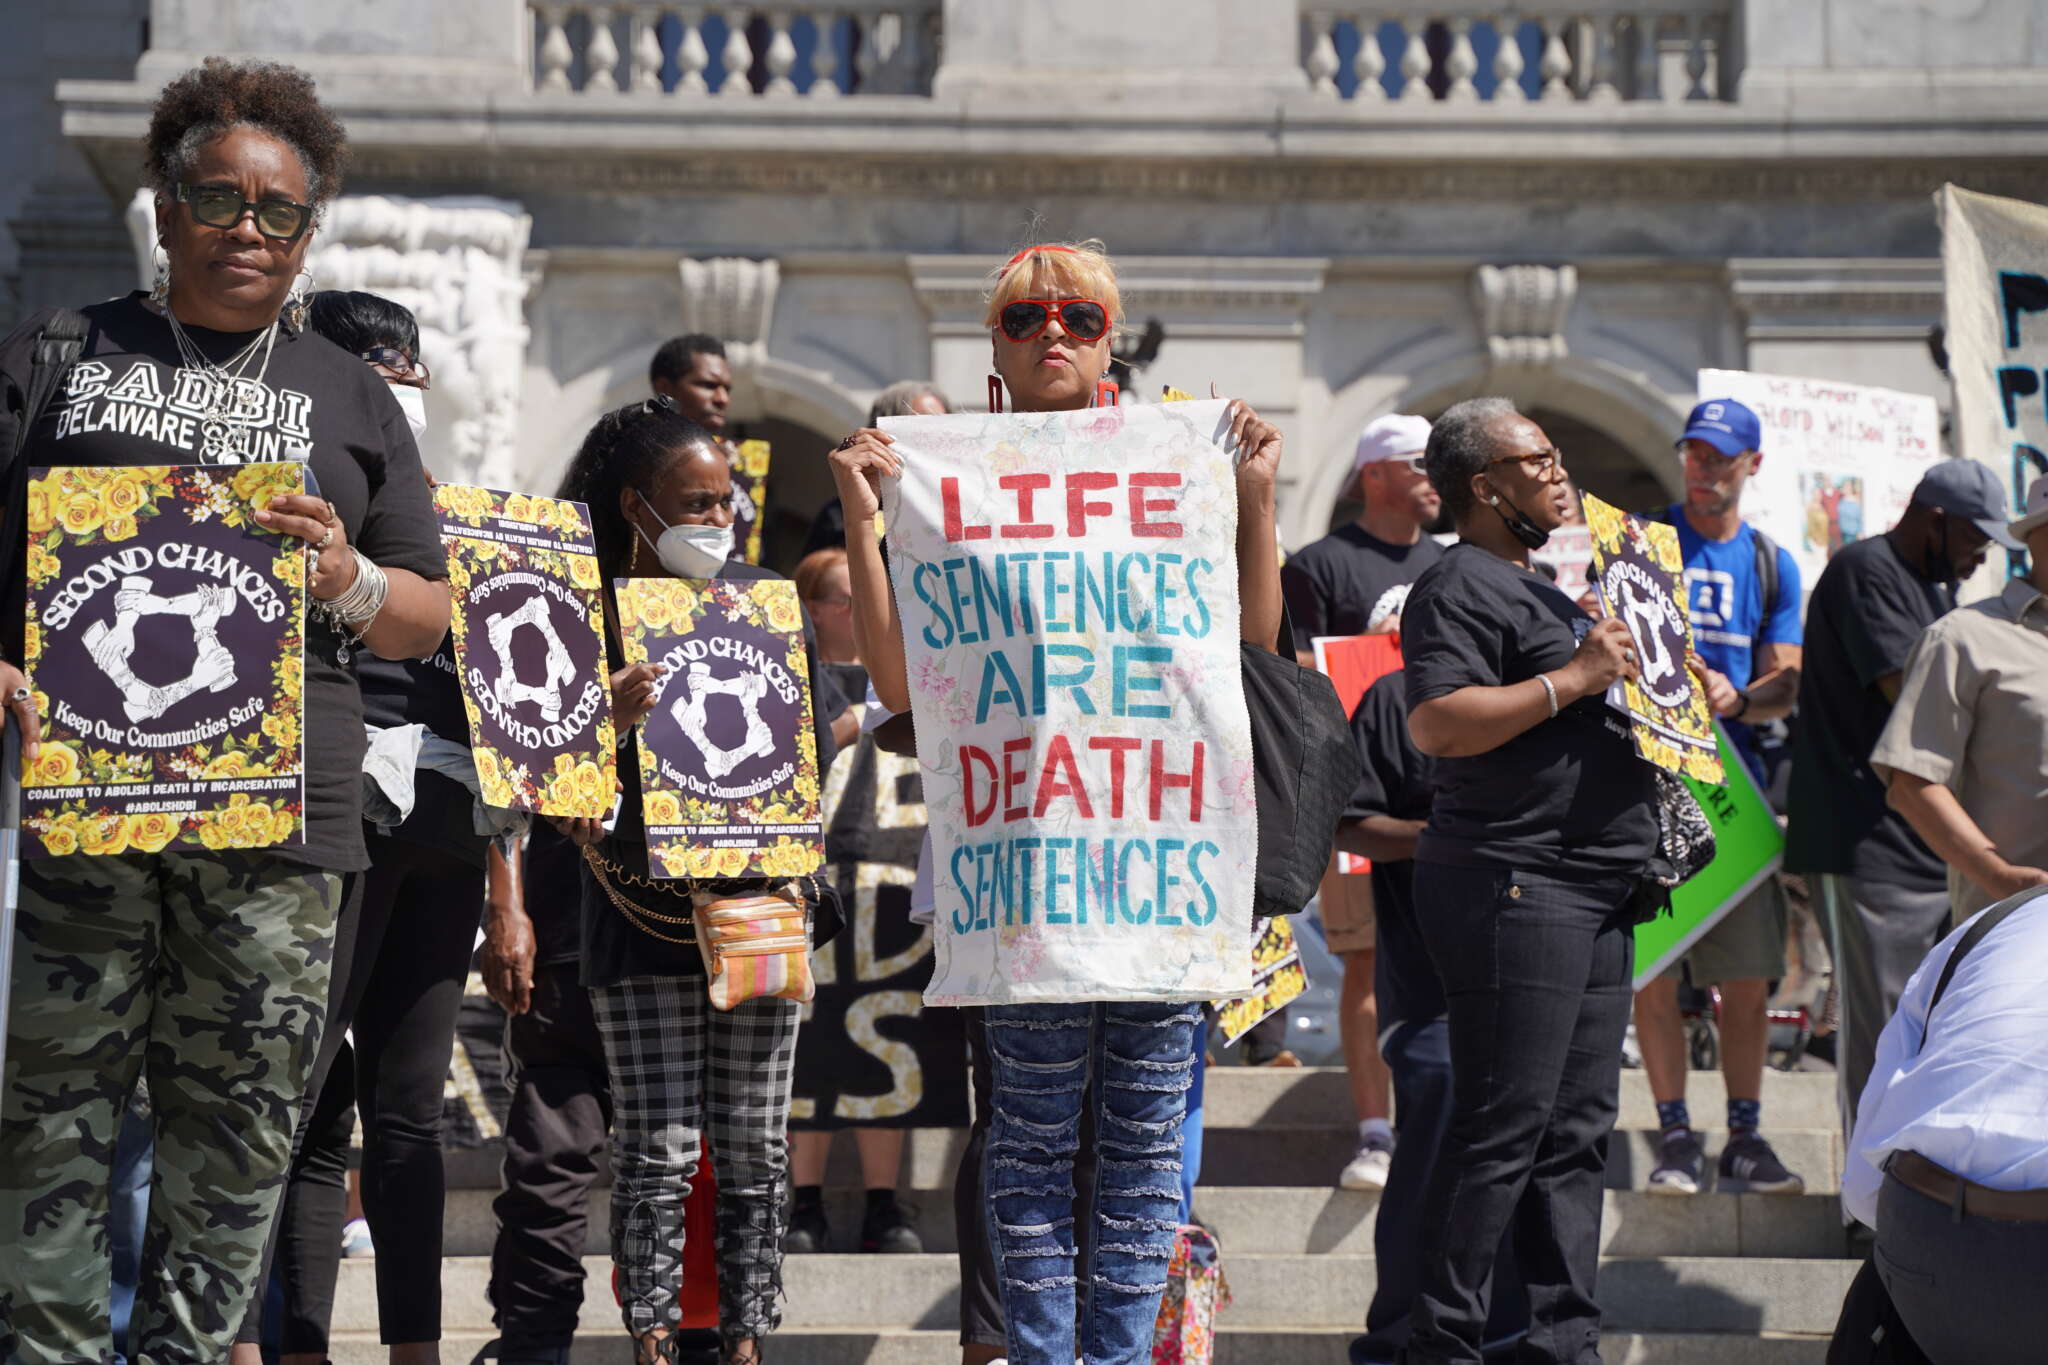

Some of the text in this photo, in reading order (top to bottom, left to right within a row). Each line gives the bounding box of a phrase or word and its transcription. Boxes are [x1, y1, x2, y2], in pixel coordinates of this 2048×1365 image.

[56, 402, 197, 450] DELAWARE
[64, 361, 313, 438] CADBI
[941, 472, 1183, 543] LIFE
[41, 542, 286, 631] SECOND CHANCES
[469, 580, 491, 605] Safe
[547, 580, 564, 602] Our
[564, 590, 586, 623] Keep
[913, 551, 1213, 649] SENTENCES
[708, 636, 800, 705] CHANCES
[975, 643, 1174, 725] ARE
[54, 697, 265, 748] Keep Our Communities Safe
[467, 667, 603, 750] SECOND CHANCES
[27, 778, 297, 800] COALITION TO ABOLISH DEATH BY INCARCERATION
[125, 800, 197, 813] #ABOLISHDBI
[661, 758, 796, 799] Keep Our Communities Safe
[959, 734, 1205, 827] DEATH
[951, 837, 1220, 936] SENTENCES
